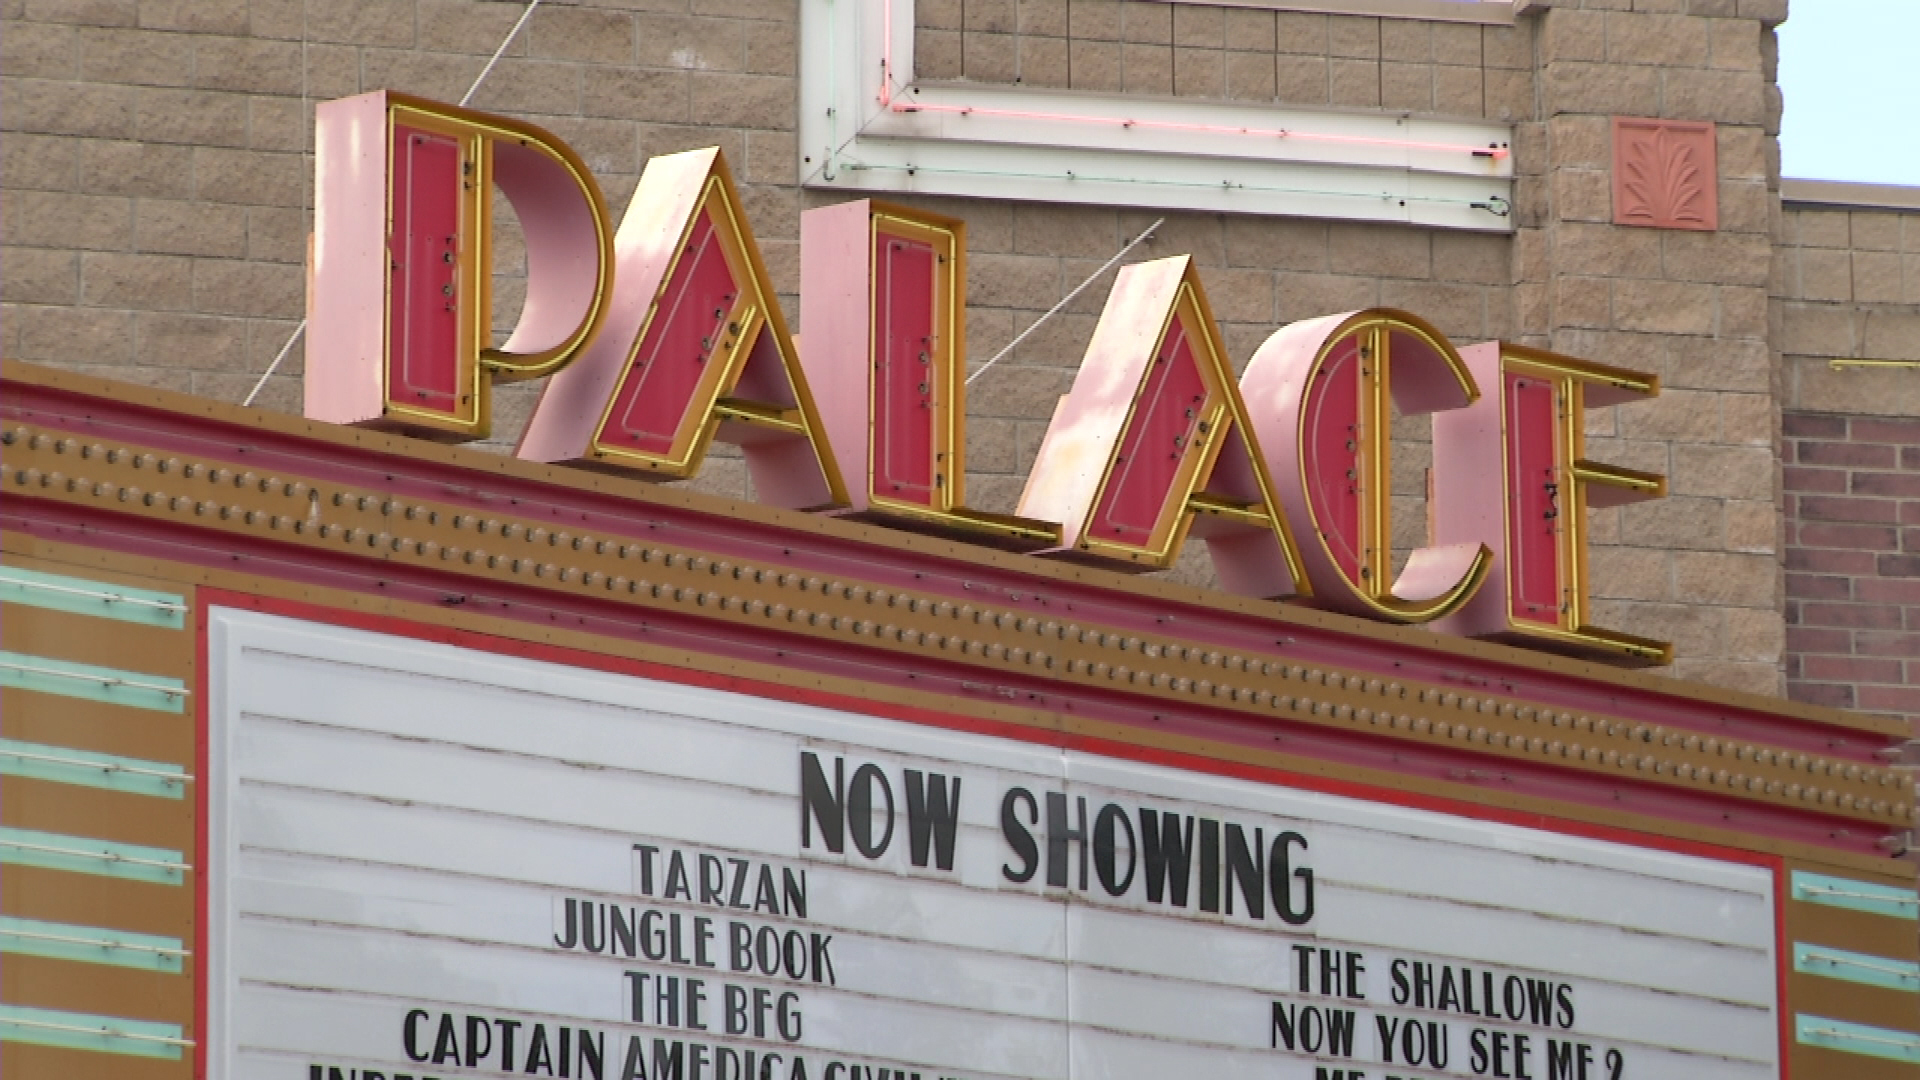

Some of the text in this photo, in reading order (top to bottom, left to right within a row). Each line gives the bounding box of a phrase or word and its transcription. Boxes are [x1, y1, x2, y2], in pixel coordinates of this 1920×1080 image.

[305, 88, 1673, 667] PALACE
[801, 751, 1315, 925] NOW SHOWING
[632, 843, 807, 918] TARZAN
[554, 898, 835, 985] JUNGLE BOOK
[624, 971, 802, 1042] THE BFG
[1292, 944, 1574, 1028] THE SHALLOWS
[403, 1008, 604, 1080] CAPTAIN
[1272, 1002, 1355, 1057] NOW
[1376, 1015, 1448, 1068] YOU
[1470, 1028, 1532, 1079] SEE
[1548, 1039, 1593, 1080] ME
